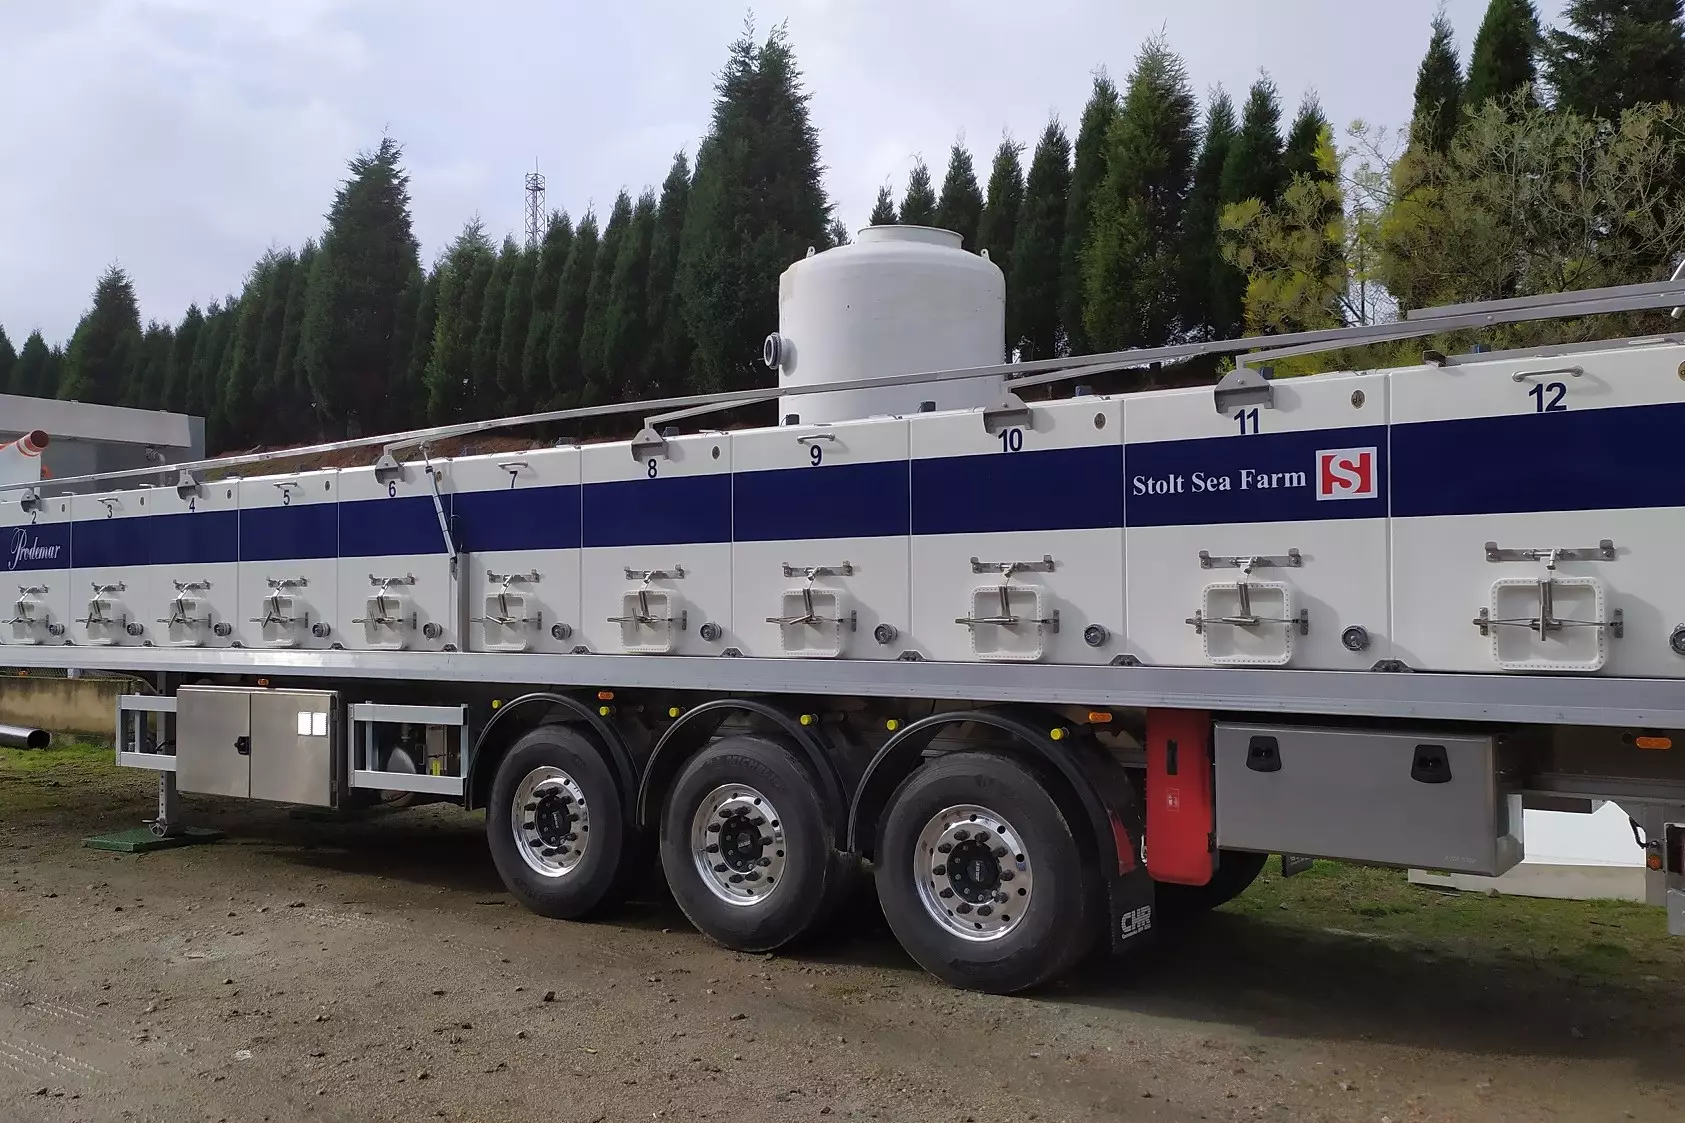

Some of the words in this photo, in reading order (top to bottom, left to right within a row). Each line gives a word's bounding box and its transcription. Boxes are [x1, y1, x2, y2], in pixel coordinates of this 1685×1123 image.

[1528, 383, 1567, 412] 12
[1233, 408, 1259, 435] 11
[997, 429, 1024, 452] 10
[810, 444, 823, 467] 9
[647, 458, 658, 479] 8
[388, 480, 397, 498] 6
[509, 470, 519, 489] 7
[1133, 474, 1185, 496] Stolt
[1191, 472, 1232, 493] Sea
[1239, 469, 1307, 490] Farm
[188, 498, 196, 513] 4
[283, 489, 291, 506] 5
[31, 510, 37, 524] 2
[107, 504, 113, 519] 3
[8, 527, 61, 570] Prodemar
